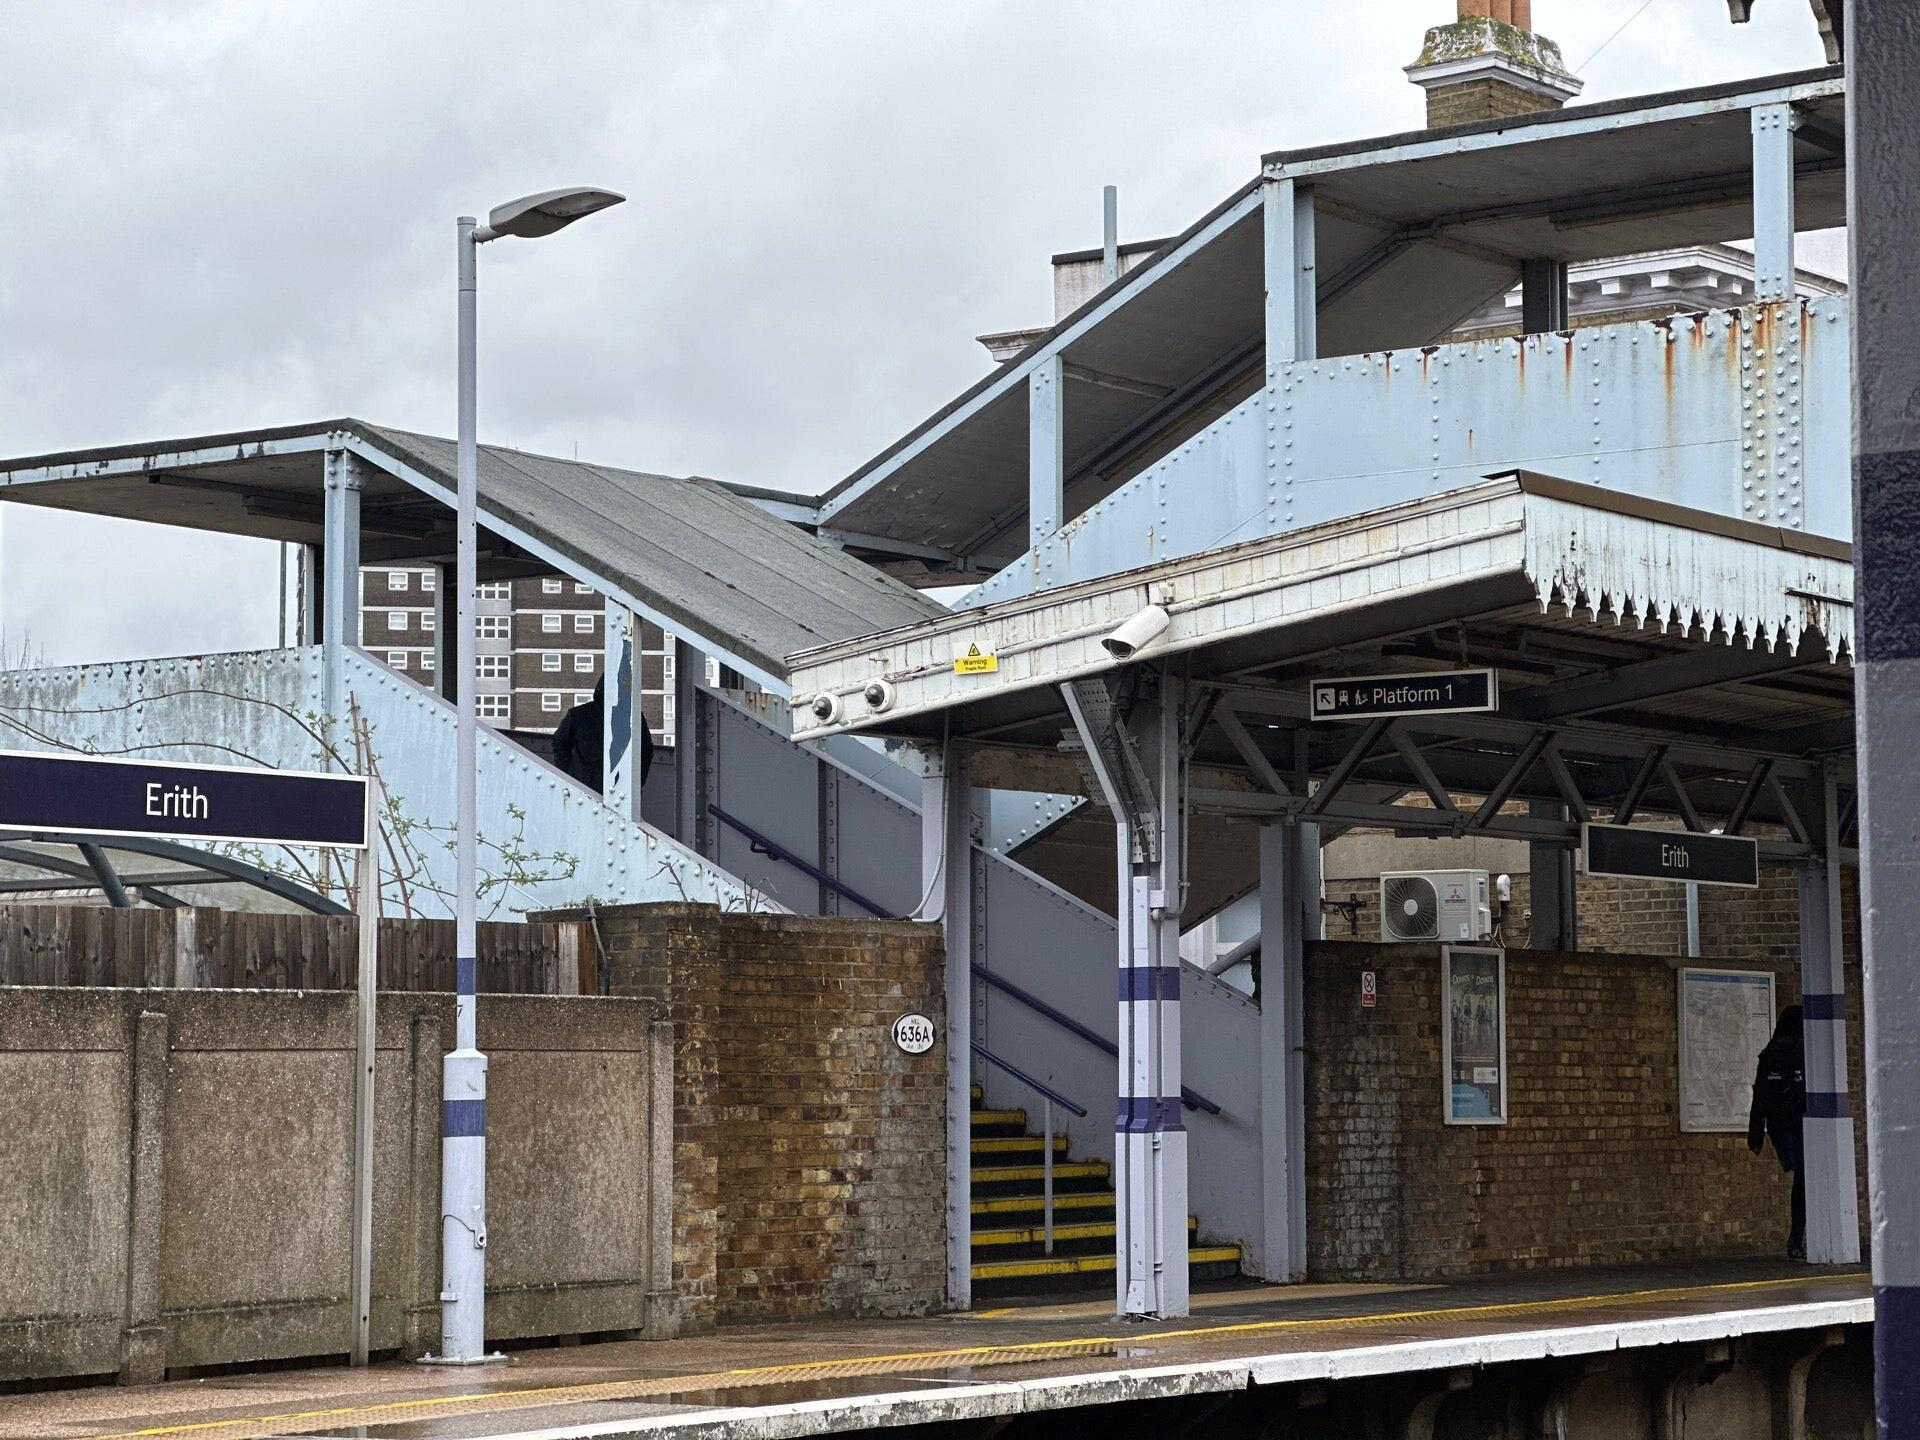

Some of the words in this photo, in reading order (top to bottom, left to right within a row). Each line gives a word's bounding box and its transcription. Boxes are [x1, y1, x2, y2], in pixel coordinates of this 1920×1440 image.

[1373, 686, 1440, 705] Platform
[1445, 684, 1453, 700] 1
[146, 782, 208, 819] Erith
[1661, 844, 1689, 868] Erith
[900, 1026, 930, 1042] 636A
